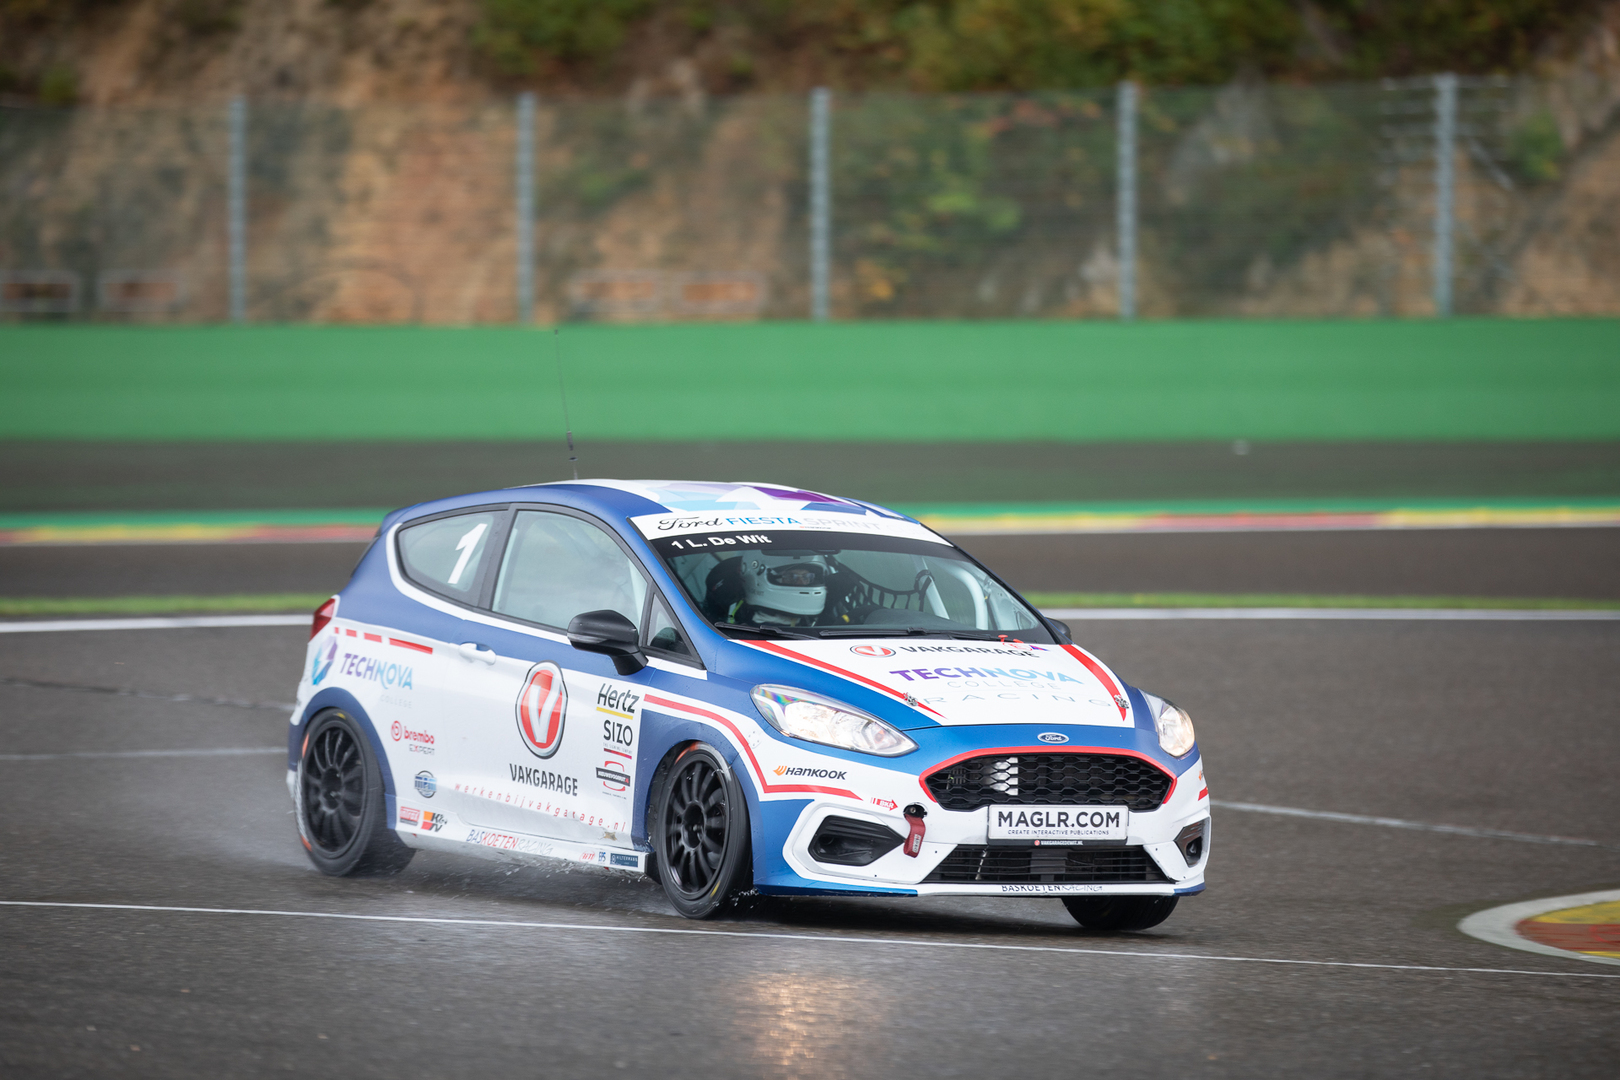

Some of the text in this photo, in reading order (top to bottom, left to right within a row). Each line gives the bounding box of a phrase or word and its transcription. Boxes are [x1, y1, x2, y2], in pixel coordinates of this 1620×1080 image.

[658, 516, 723, 530] Ford
[726, 517, 802, 526] FIESTA
[803, 518, 881, 530] SPRINT
[671, 540, 684, 549] 1
[686, 539, 708, 548] L.
[447, 523, 488, 584] 1
[899, 646, 1040, 658] VAKGARAGE
[340, 653, 413, 690] TECHNOVA
[889, 667, 1084, 684] TECHNOVA
[947, 680, 1062, 690] COLLEGE
[597, 683, 640, 714] Hertz
[923, 692, 1111, 707] RACING
[404, 725, 435, 745] brembo
[603, 719, 633, 746] SIZO
[509, 763, 578, 796] VAKGARAGE
[998, 811, 1120, 828] MAGLR.COM
